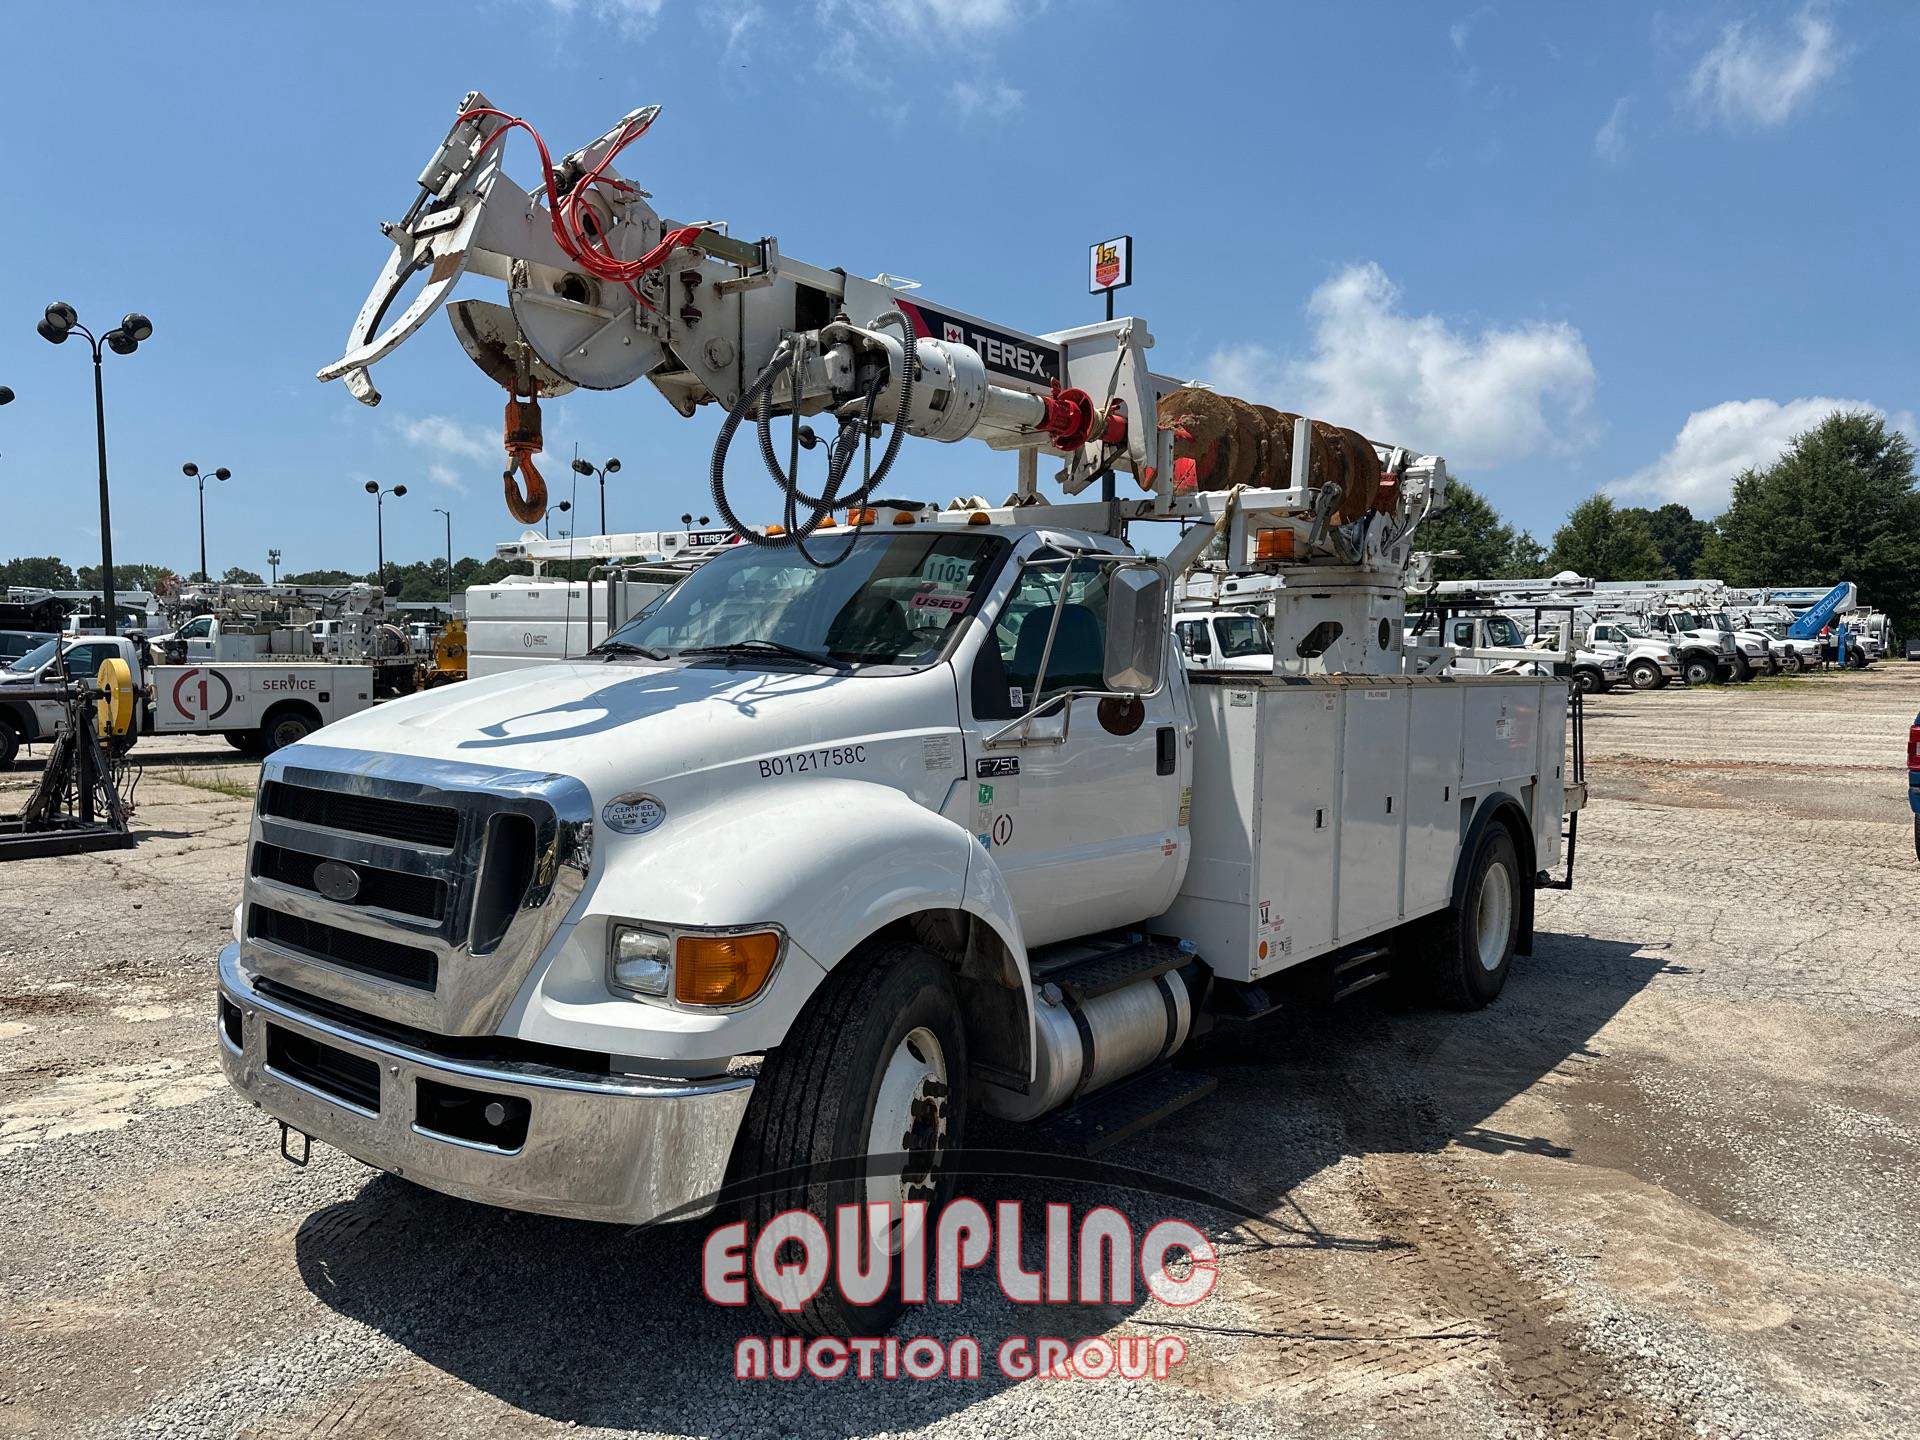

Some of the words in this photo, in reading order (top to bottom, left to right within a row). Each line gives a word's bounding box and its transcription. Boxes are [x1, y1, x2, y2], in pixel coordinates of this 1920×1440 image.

[1096, 243, 1116, 264] 1ST
[971, 333, 1047, 378] TEREX
[699, 533, 728, 544] TEREX
[928, 562, 966, 583] 1105
[916, 597, 963, 609] USED
[262, 679, 317, 690] SERVICE
[759, 745, 866, 778] B0121758C
[612, 812, 638, 820] CLEAN
[640, 810, 657, 818] IDLE
[614, 804, 654, 814] CERTIFIED
